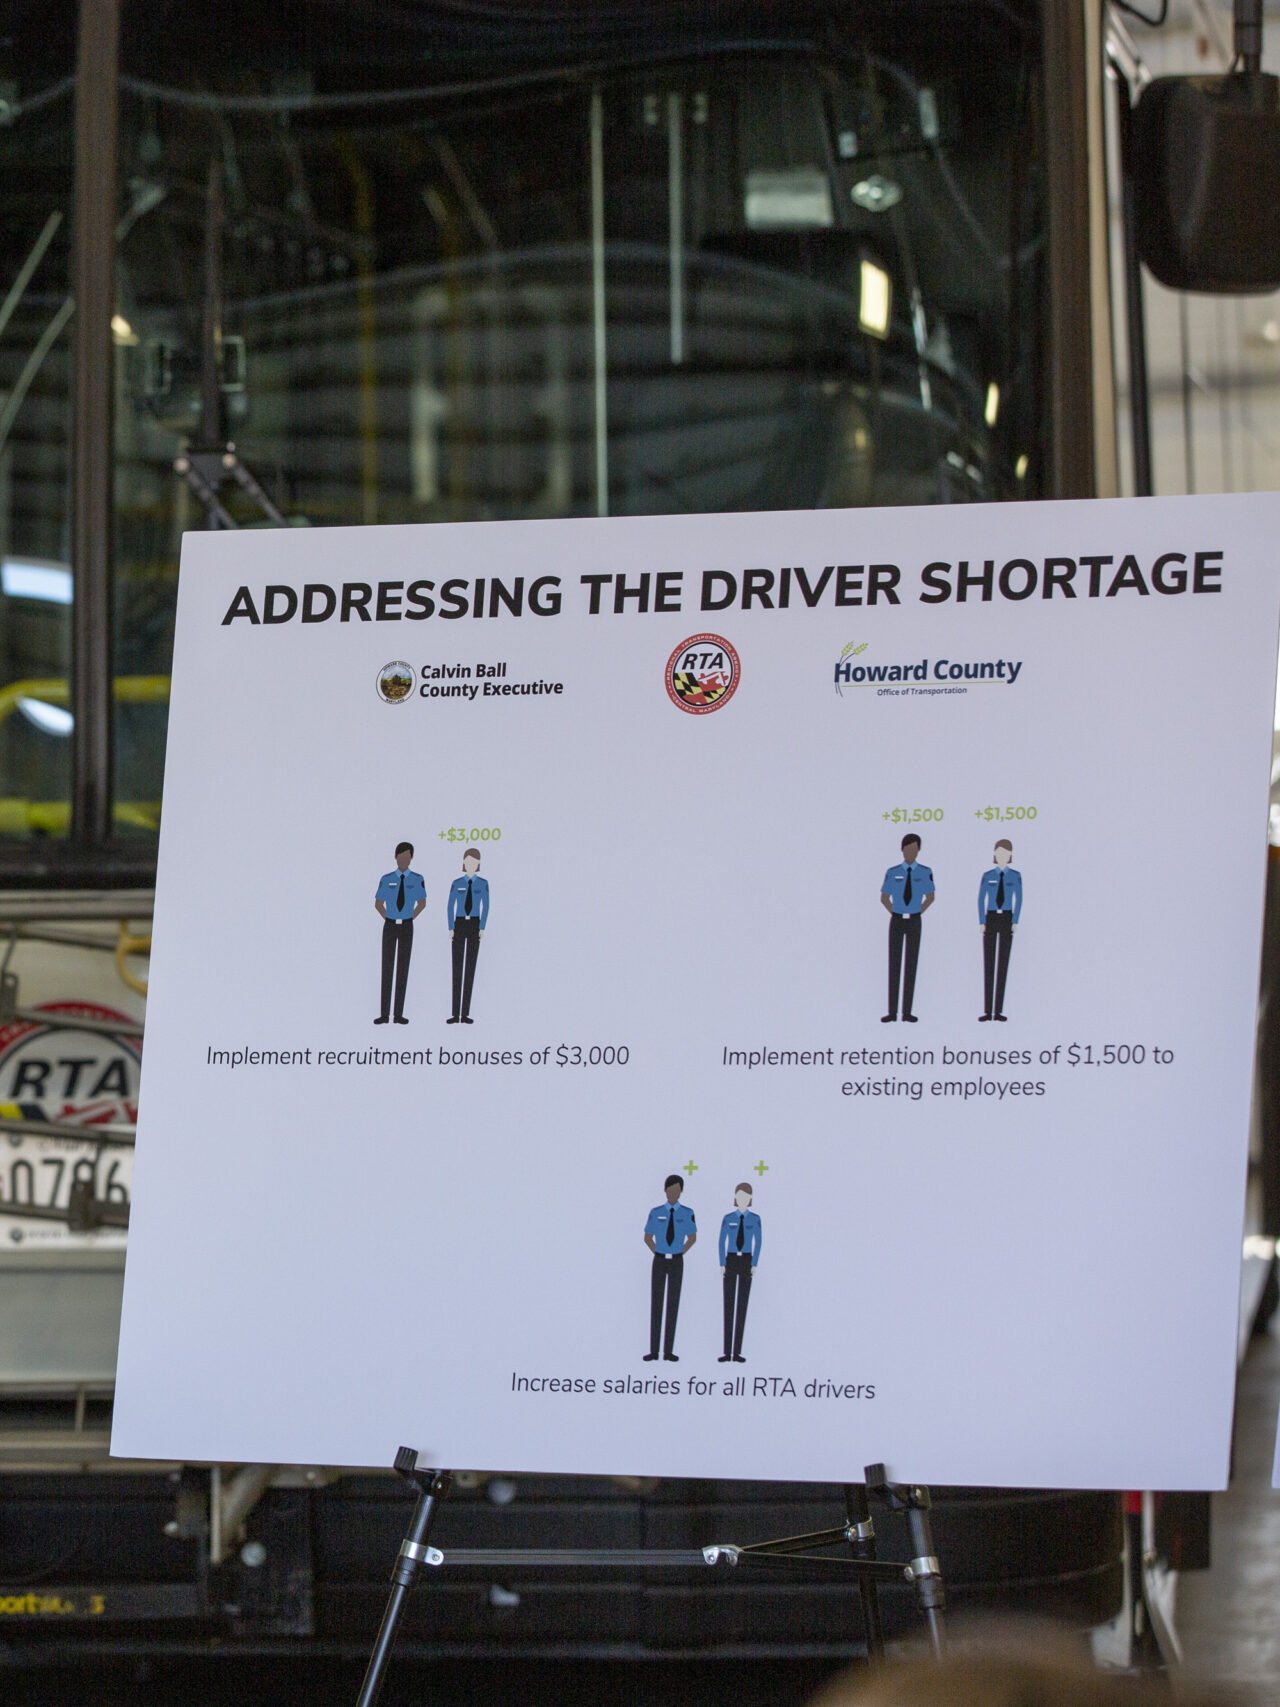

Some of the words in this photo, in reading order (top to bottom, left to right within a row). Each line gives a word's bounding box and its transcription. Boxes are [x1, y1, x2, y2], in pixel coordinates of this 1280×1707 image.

[221, 575, 562, 626] ADDRESSING
[580, 571, 684, 615] THE
[700, 564, 902, 611] DRIVER
[919, 550, 1224, 604] SHORTAGE
[421, 664, 471, 679] Calvin
[475, 662, 507, 678] Ball
[681, 652, 723, 669] RTA
[834, 659, 928, 683] Howard
[933, 659, 1023, 684] County
[419, 683, 479, 701] County
[483, 679, 564, 696] Executive
[876, 686, 900, 696] Office
[901, 686, 910, 696] of
[911, 686, 968, 696] Transportation
[882, 808, 944, 824] +$1,500
[974, 805, 1037, 822] +$1,500
[438, 826, 502, 844] +$3,000
[207, 1046, 312, 1069] Implement
[318, 1047, 433, 1066] recruitment
[438, 1046, 524, 1065] bonuses
[529, 1046, 551, 1065] of
[555, 1043, 631, 1069] $3,000
[722, 1046, 835, 1068] Implement
[840, 1046, 935, 1065] retention
[942, 1046, 1033, 1065] bonuses
[1038, 1045, 1061, 1065] of
[1066, 1042, 1146, 1068] $1,500
[1152, 1046, 1175, 1065] to
[11, 1057, 128, 1099] RTA
[841, 1077, 923, 1100] existing
[930, 1077, 1046, 1100] employees
[511, 1372, 597, 1394] Increase
[603, 1375, 681, 1396] salaries
[687, 1376, 717, 1396] for
[722, 1377, 746, 1397] all
[753, 1378, 797, 1398] RTA
[804, 1379, 876, 1399] drivers
